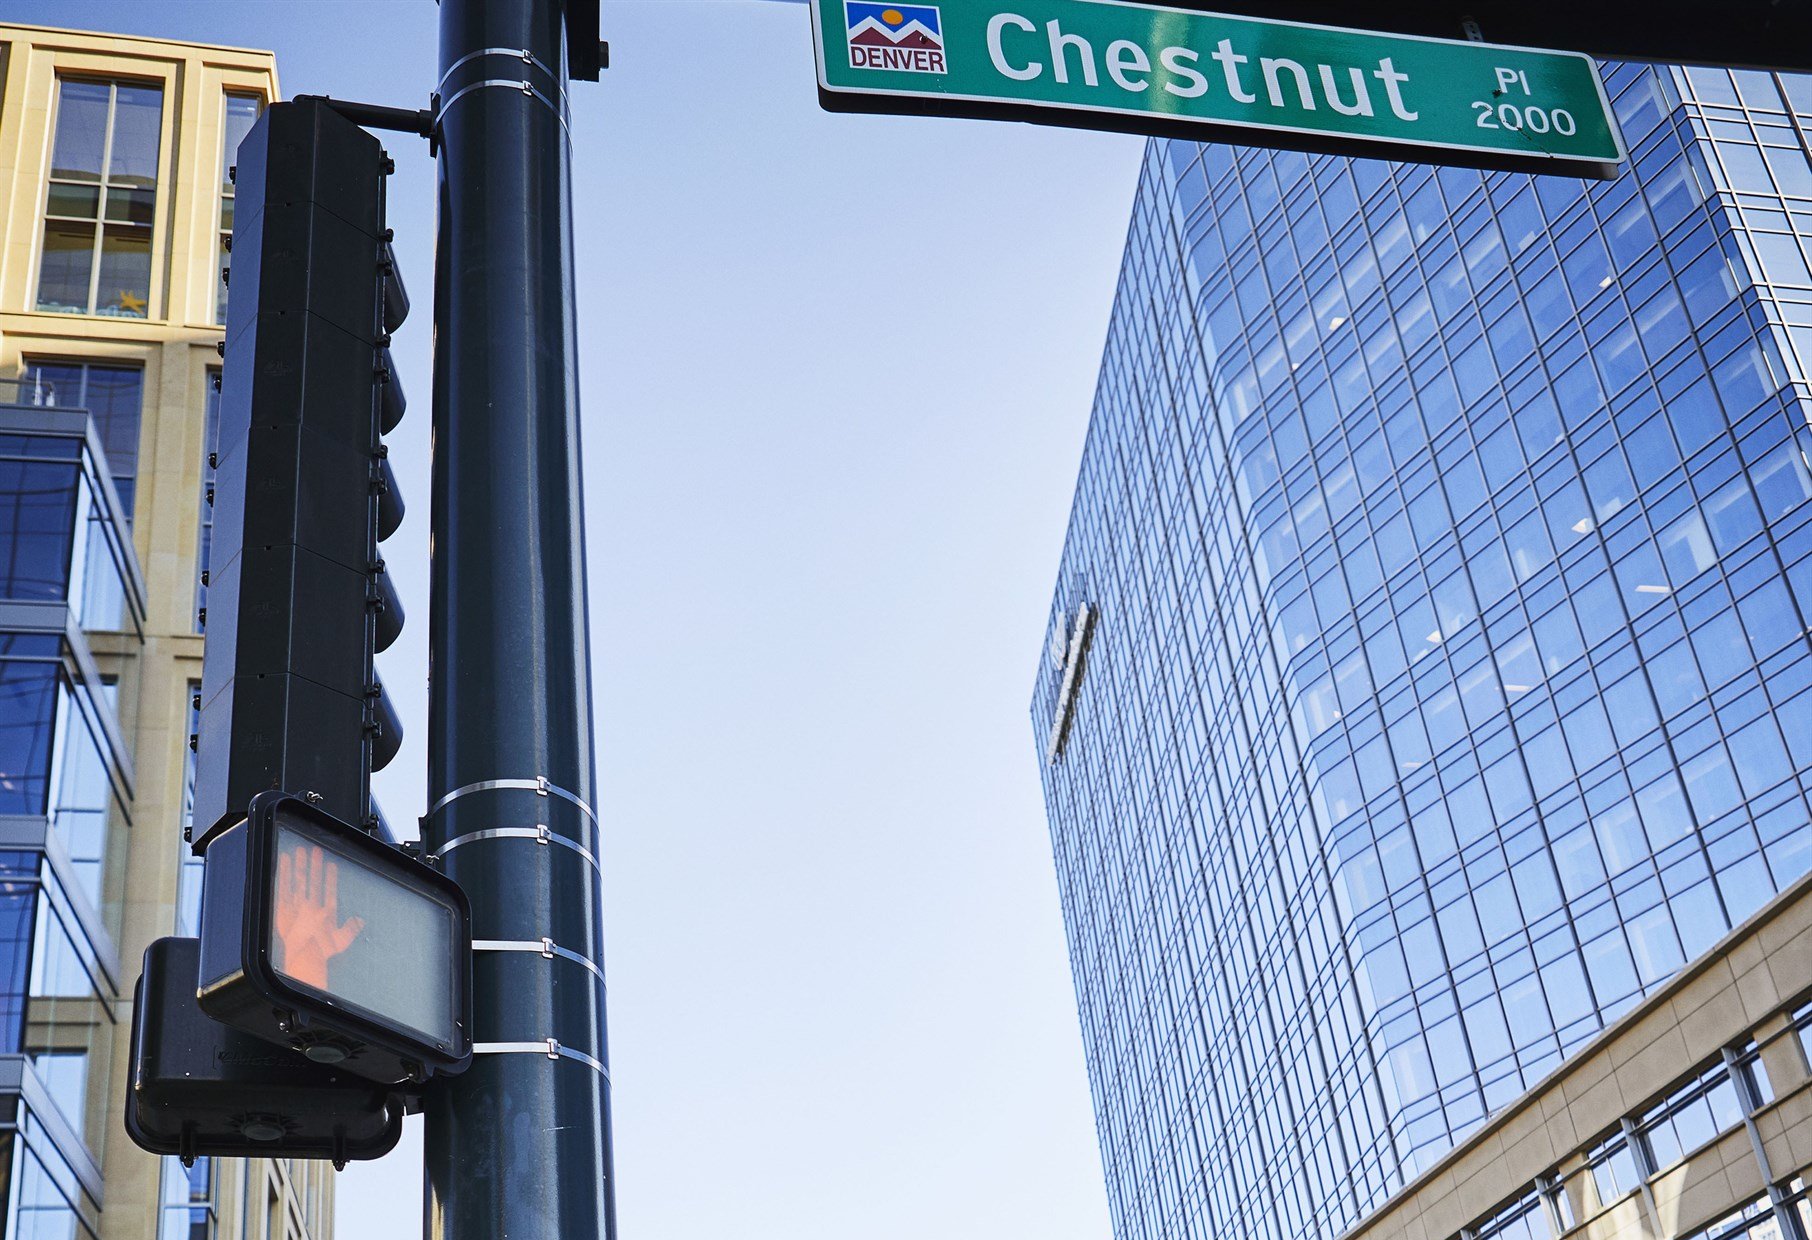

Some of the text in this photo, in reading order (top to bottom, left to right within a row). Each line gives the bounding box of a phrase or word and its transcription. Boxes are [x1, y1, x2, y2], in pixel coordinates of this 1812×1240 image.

[850, 46, 944, 72] DENVER
[985, 12, 1419, 123] Chestnut
[1494, 67, 1531, 96] Pl
[1471, 101, 1576, 136] 2000
